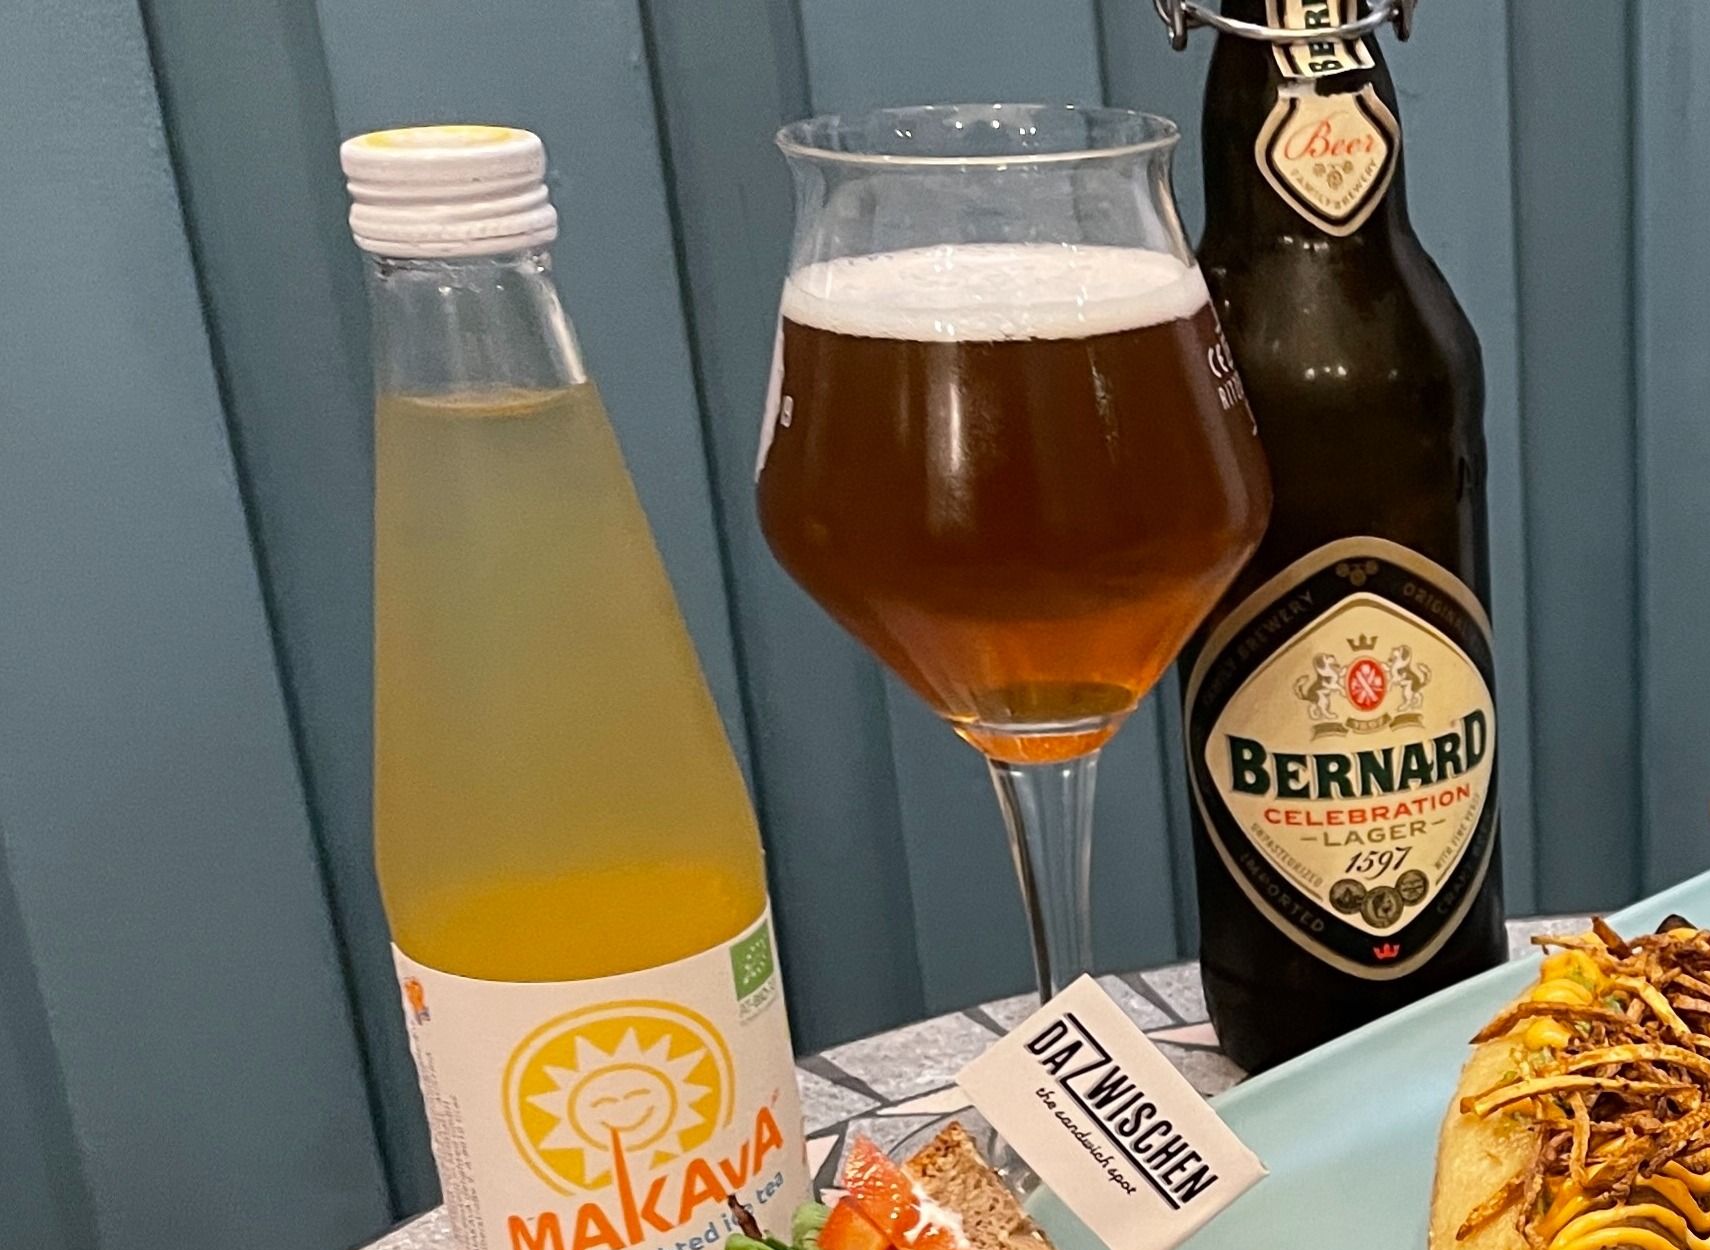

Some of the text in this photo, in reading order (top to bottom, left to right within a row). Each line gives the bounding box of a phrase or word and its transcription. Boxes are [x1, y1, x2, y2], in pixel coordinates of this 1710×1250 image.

[1303, 0, 1343, 73] BER
[1283, 111, 1376, 160] Beer
[1225, 708, 1487, 800] BERNARD
[1263, 783, 1472, 827] CELEBRATION
[1322, 820, 1430, 848] LAGER
[1240, 852, 1326, 934] IMPORTED
[1344, 845, 1413, 880] 1597
[1024, 1012, 1219, 1211] DAZWISCHEN
[1035, 1086, 1137, 1196] the sandwich spot
[754, 1171, 785, 1204] tea
